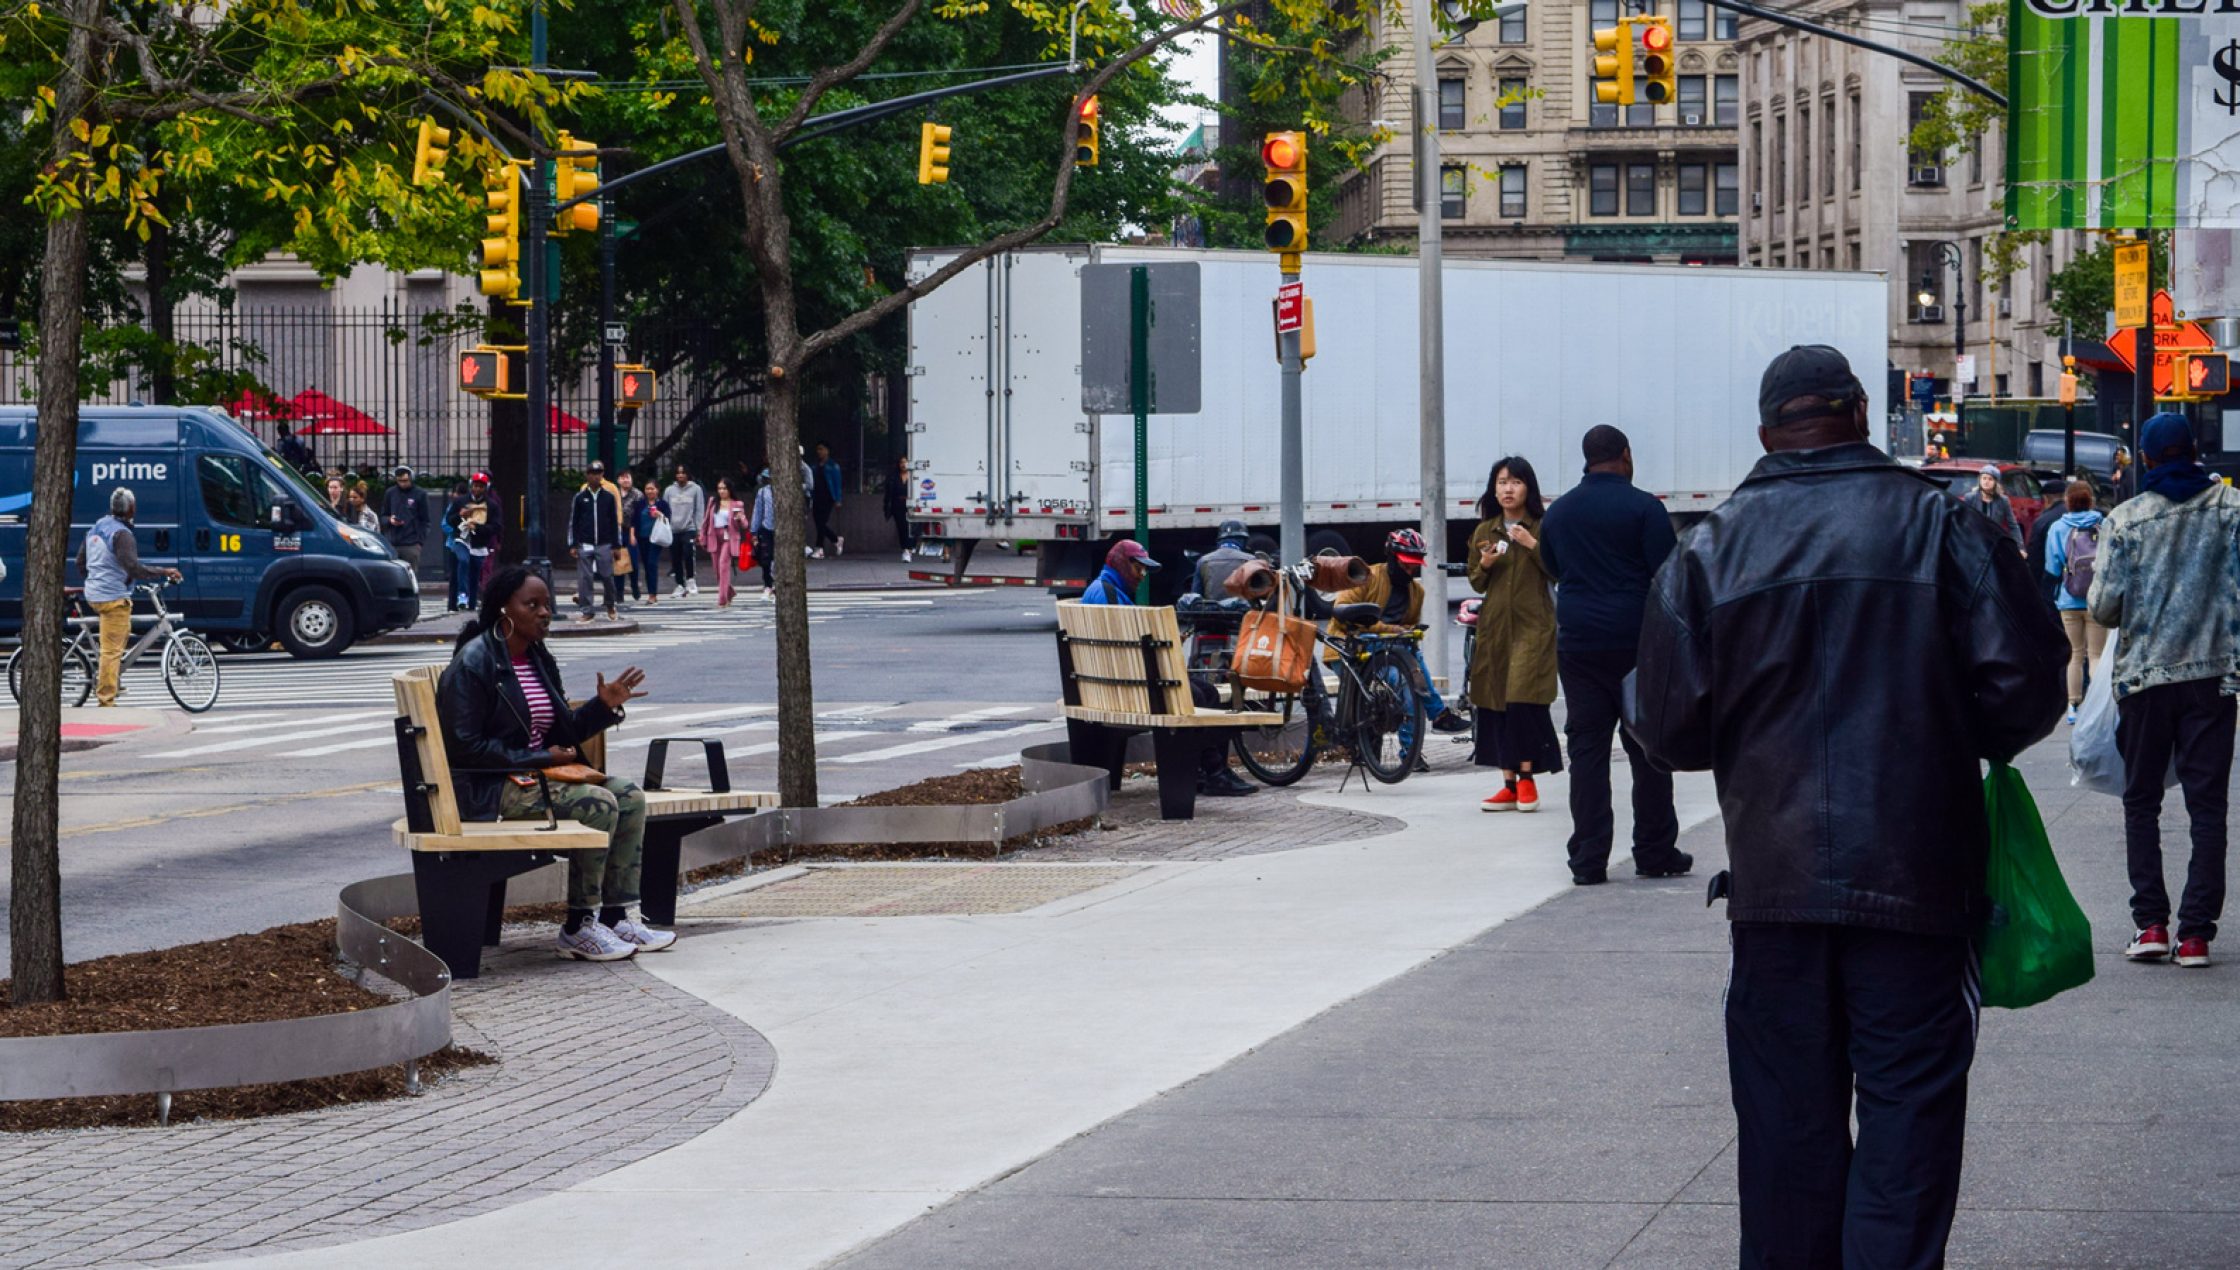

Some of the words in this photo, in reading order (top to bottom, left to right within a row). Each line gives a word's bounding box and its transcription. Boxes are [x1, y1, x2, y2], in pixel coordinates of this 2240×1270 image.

[2153, 333, 2179, 346] ORK
[92, 456, 168, 486] prime
[220, 533, 242, 553] 16
